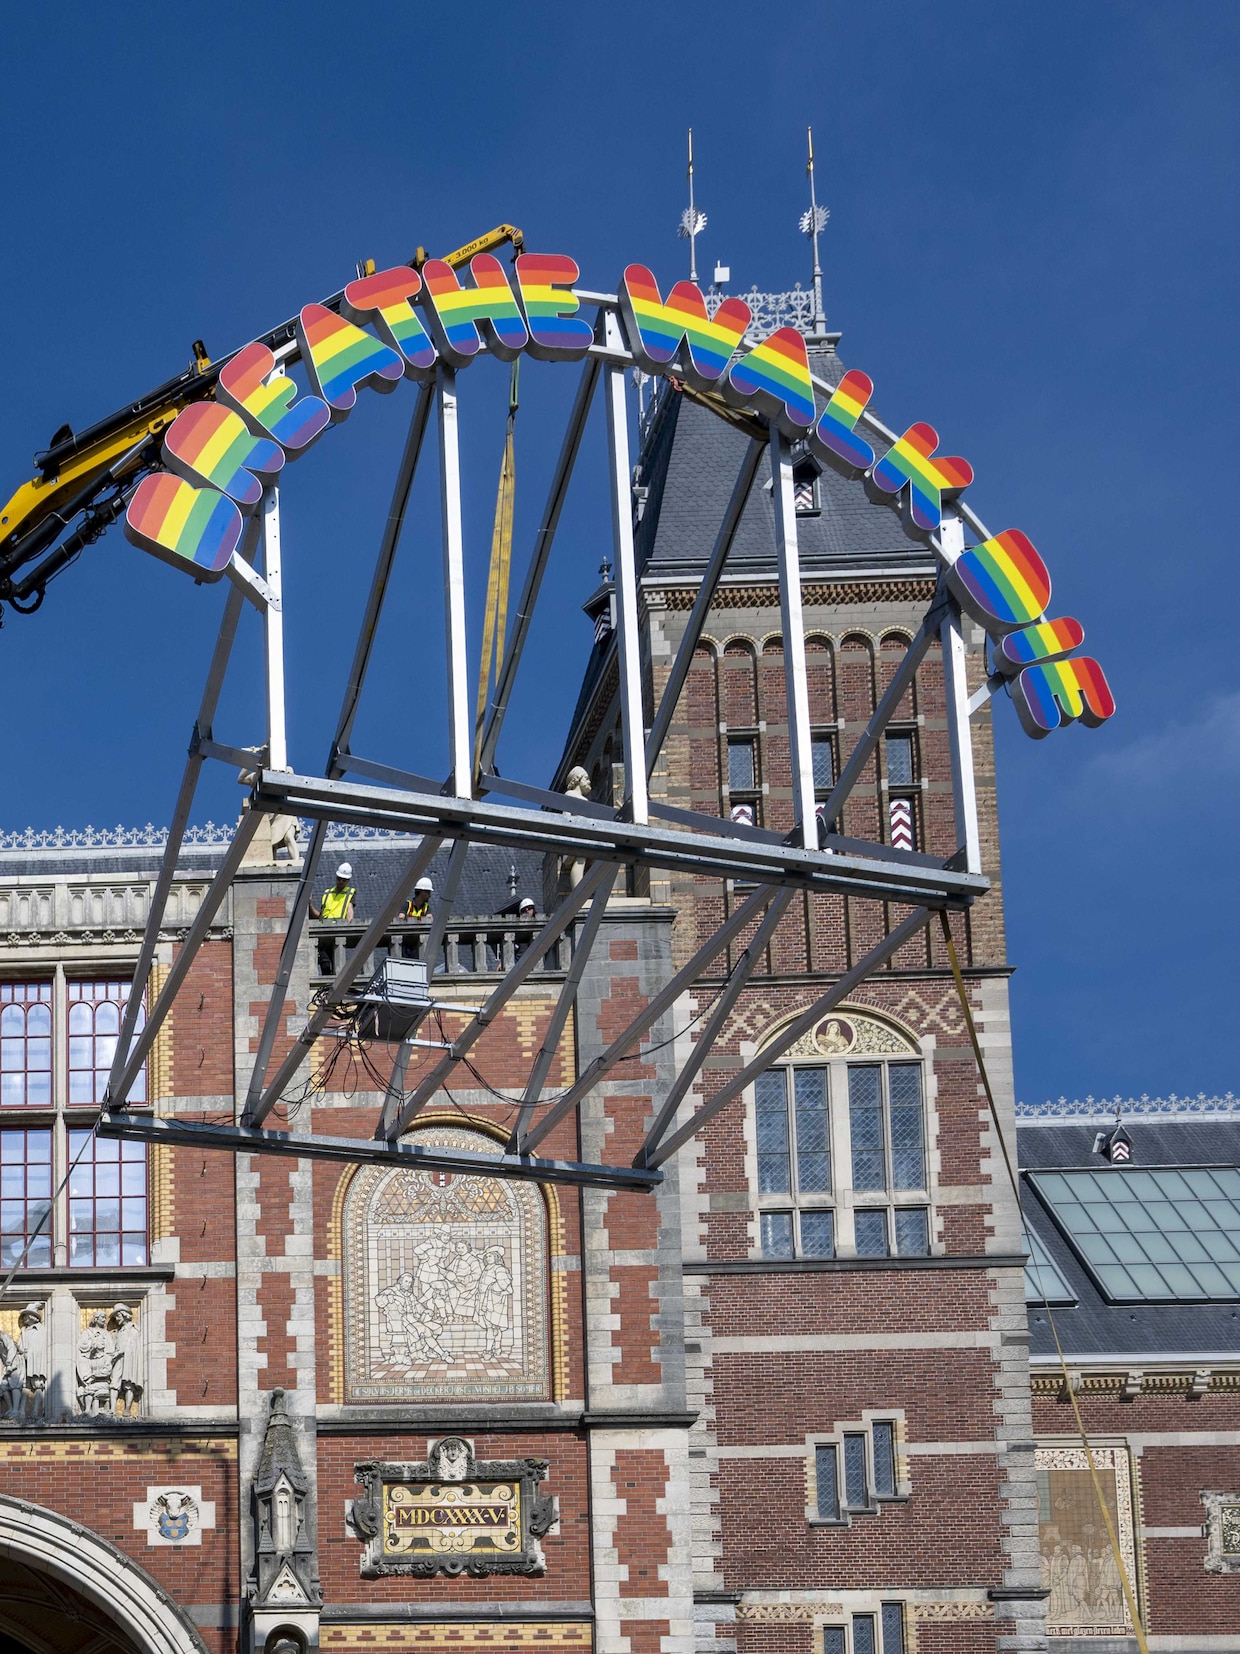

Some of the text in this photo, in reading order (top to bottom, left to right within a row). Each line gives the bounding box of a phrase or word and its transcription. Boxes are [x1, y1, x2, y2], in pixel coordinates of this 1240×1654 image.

[455, 243, 477, 258] 3.000
[124, 252, 1116, 732] BREATHE WALK DIE
